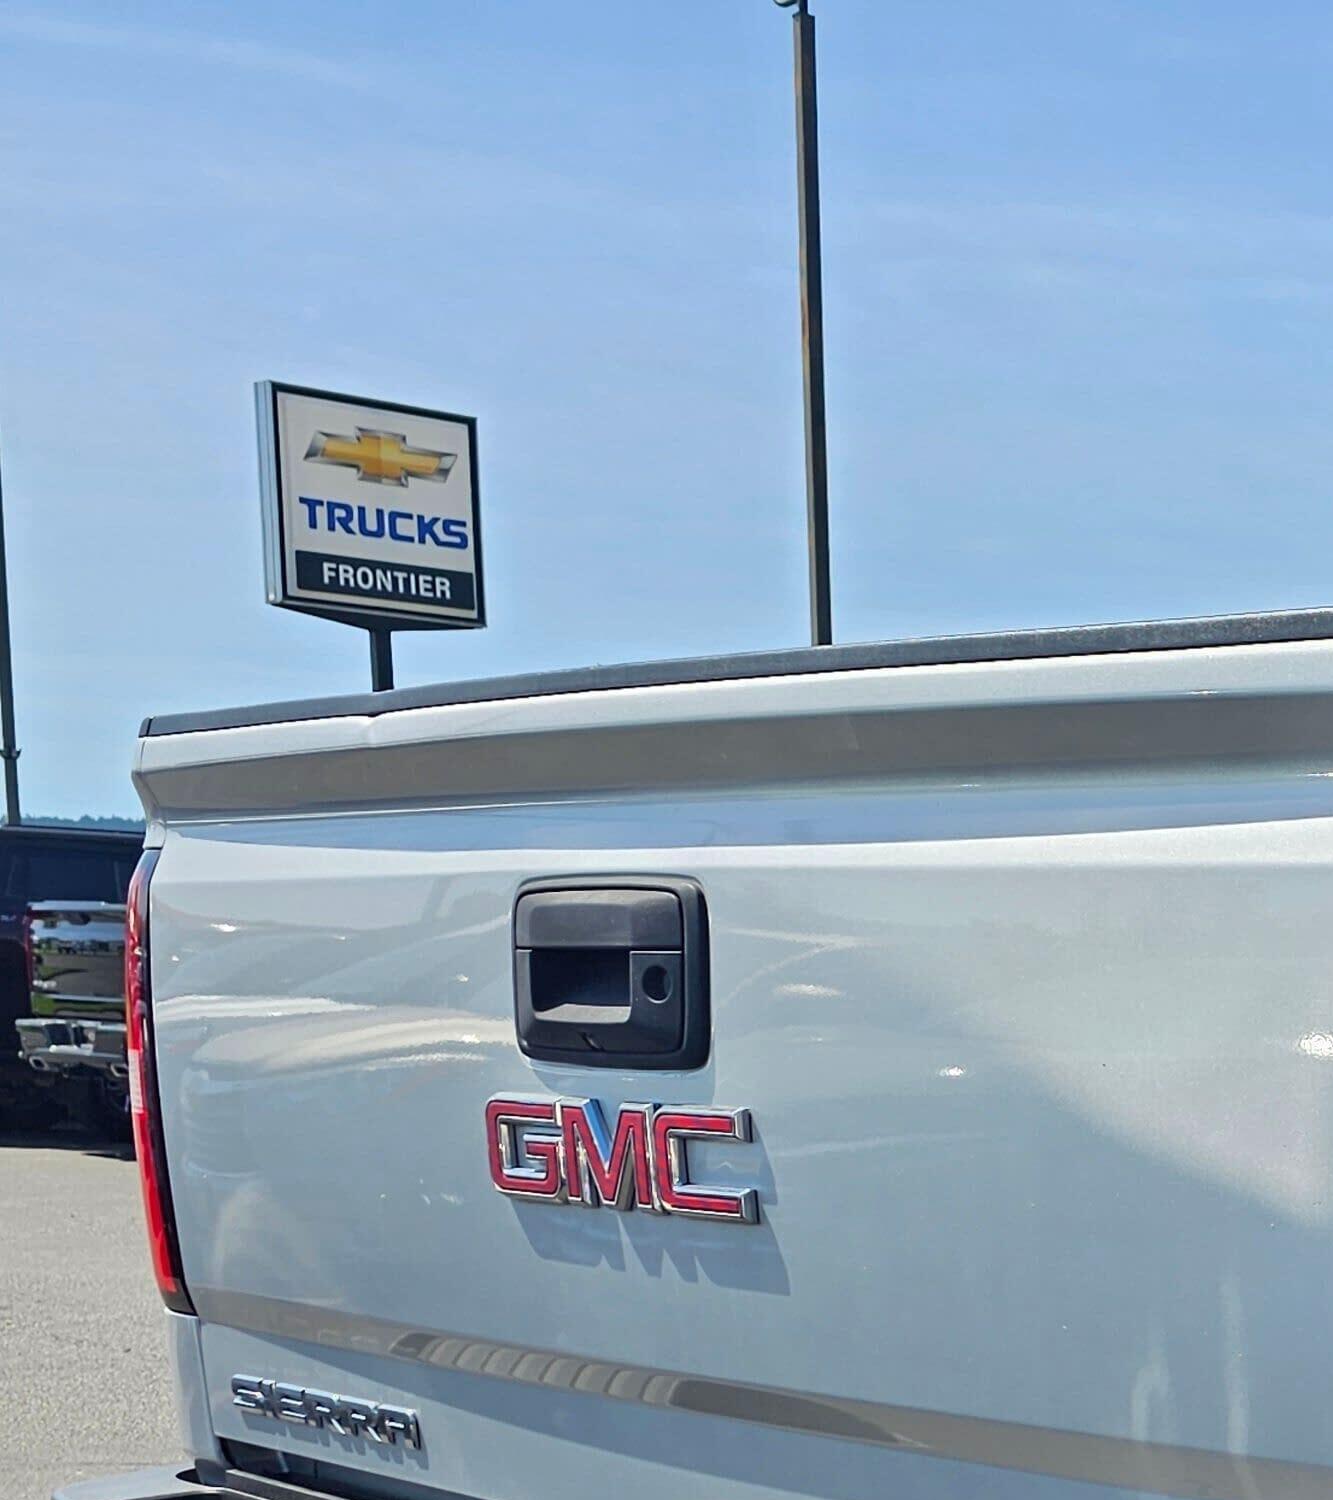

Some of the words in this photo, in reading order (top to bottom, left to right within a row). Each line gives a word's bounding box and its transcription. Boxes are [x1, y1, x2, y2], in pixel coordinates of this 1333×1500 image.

[299, 496, 469, 549] TRUCKS
[322, 561, 451, 599] FRONTIER
[485, 1091, 761, 1224] GMC
[231, 1373, 422, 1450] SIERRA
